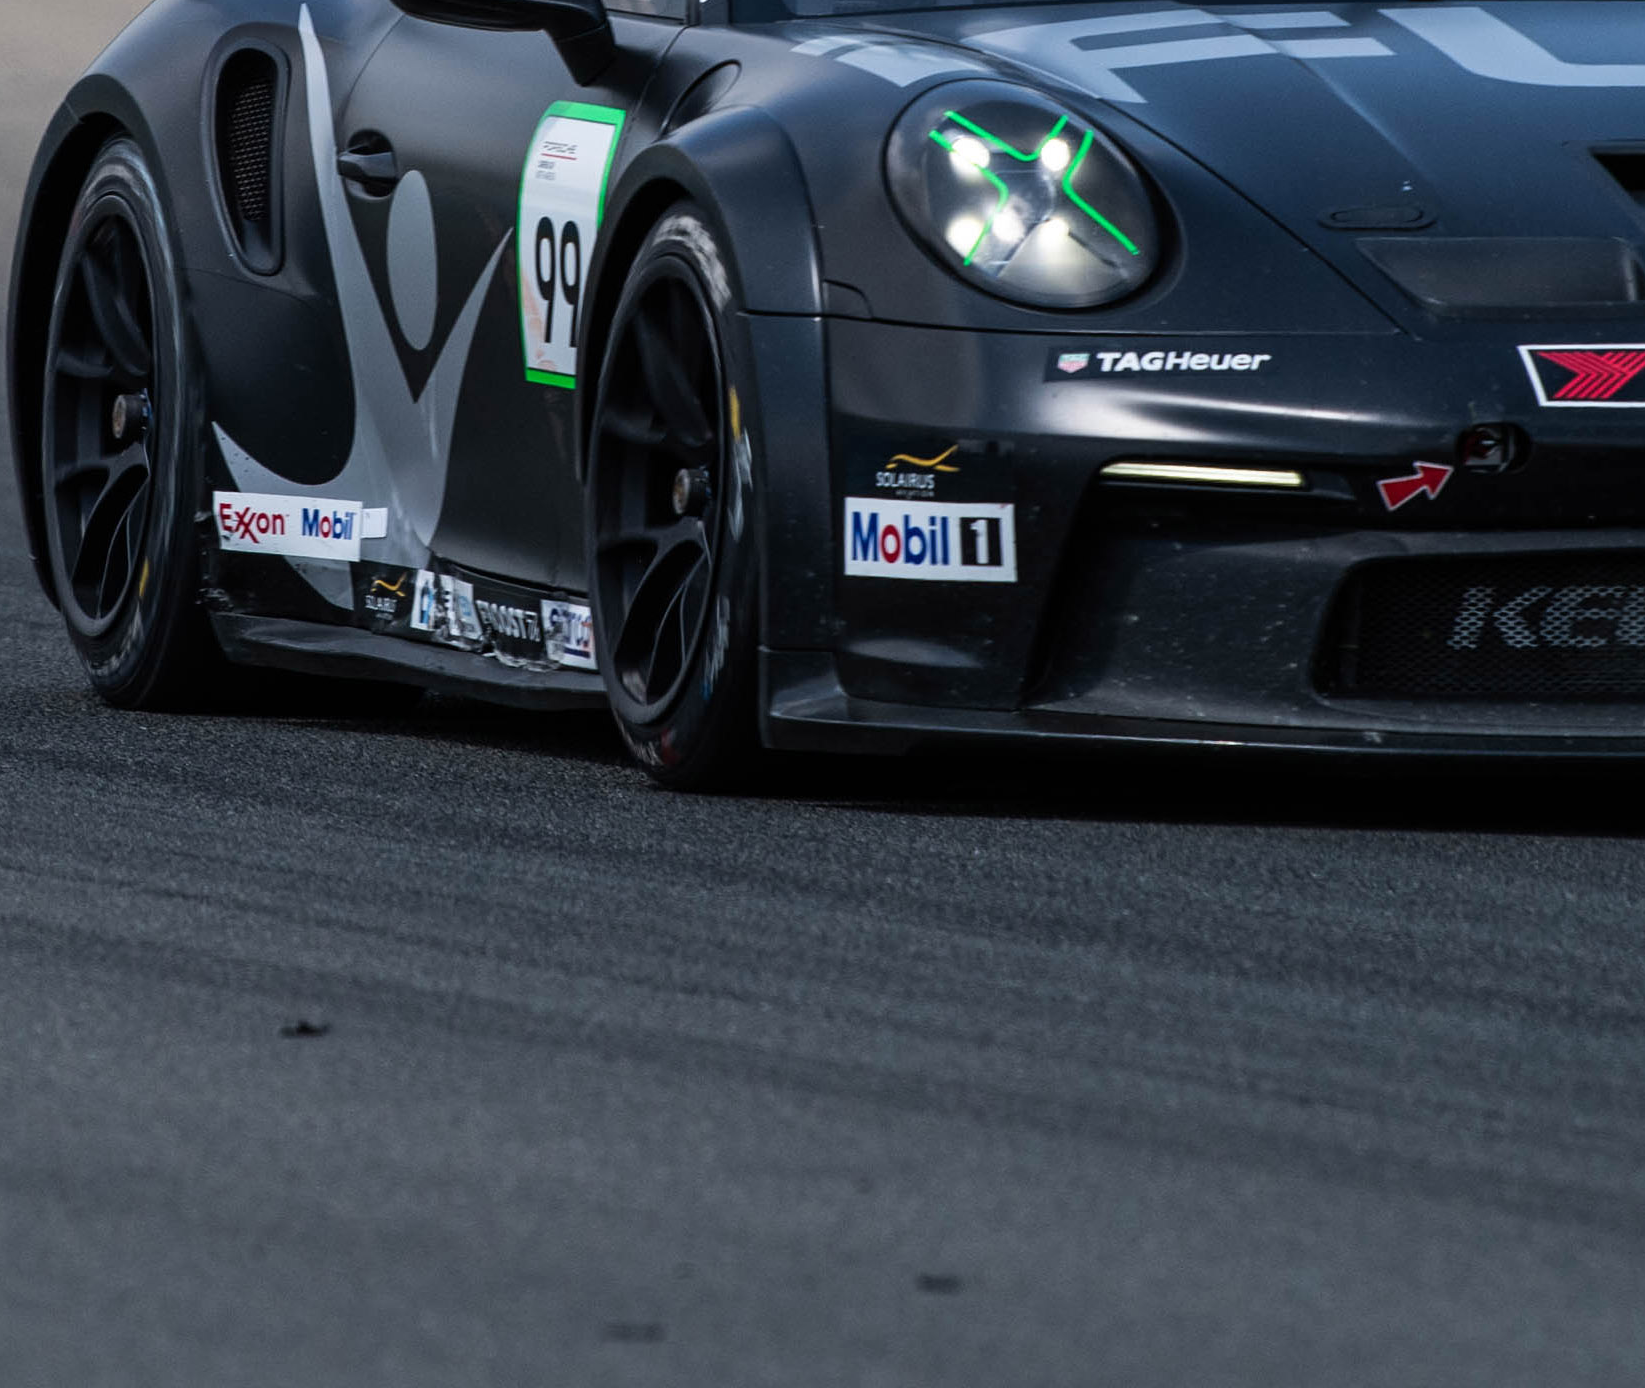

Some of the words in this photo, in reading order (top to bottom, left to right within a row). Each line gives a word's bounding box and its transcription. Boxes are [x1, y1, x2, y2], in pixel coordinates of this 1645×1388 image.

[535, 216, 581, 348] 99
[875, 471, 936, 490] SOLAIRUS
[219, 502, 286, 544] Exxon
[302, 507, 354, 541] Mobil
[852, 511, 950, 566] Mobil
[967, 517, 992, 566] 1
